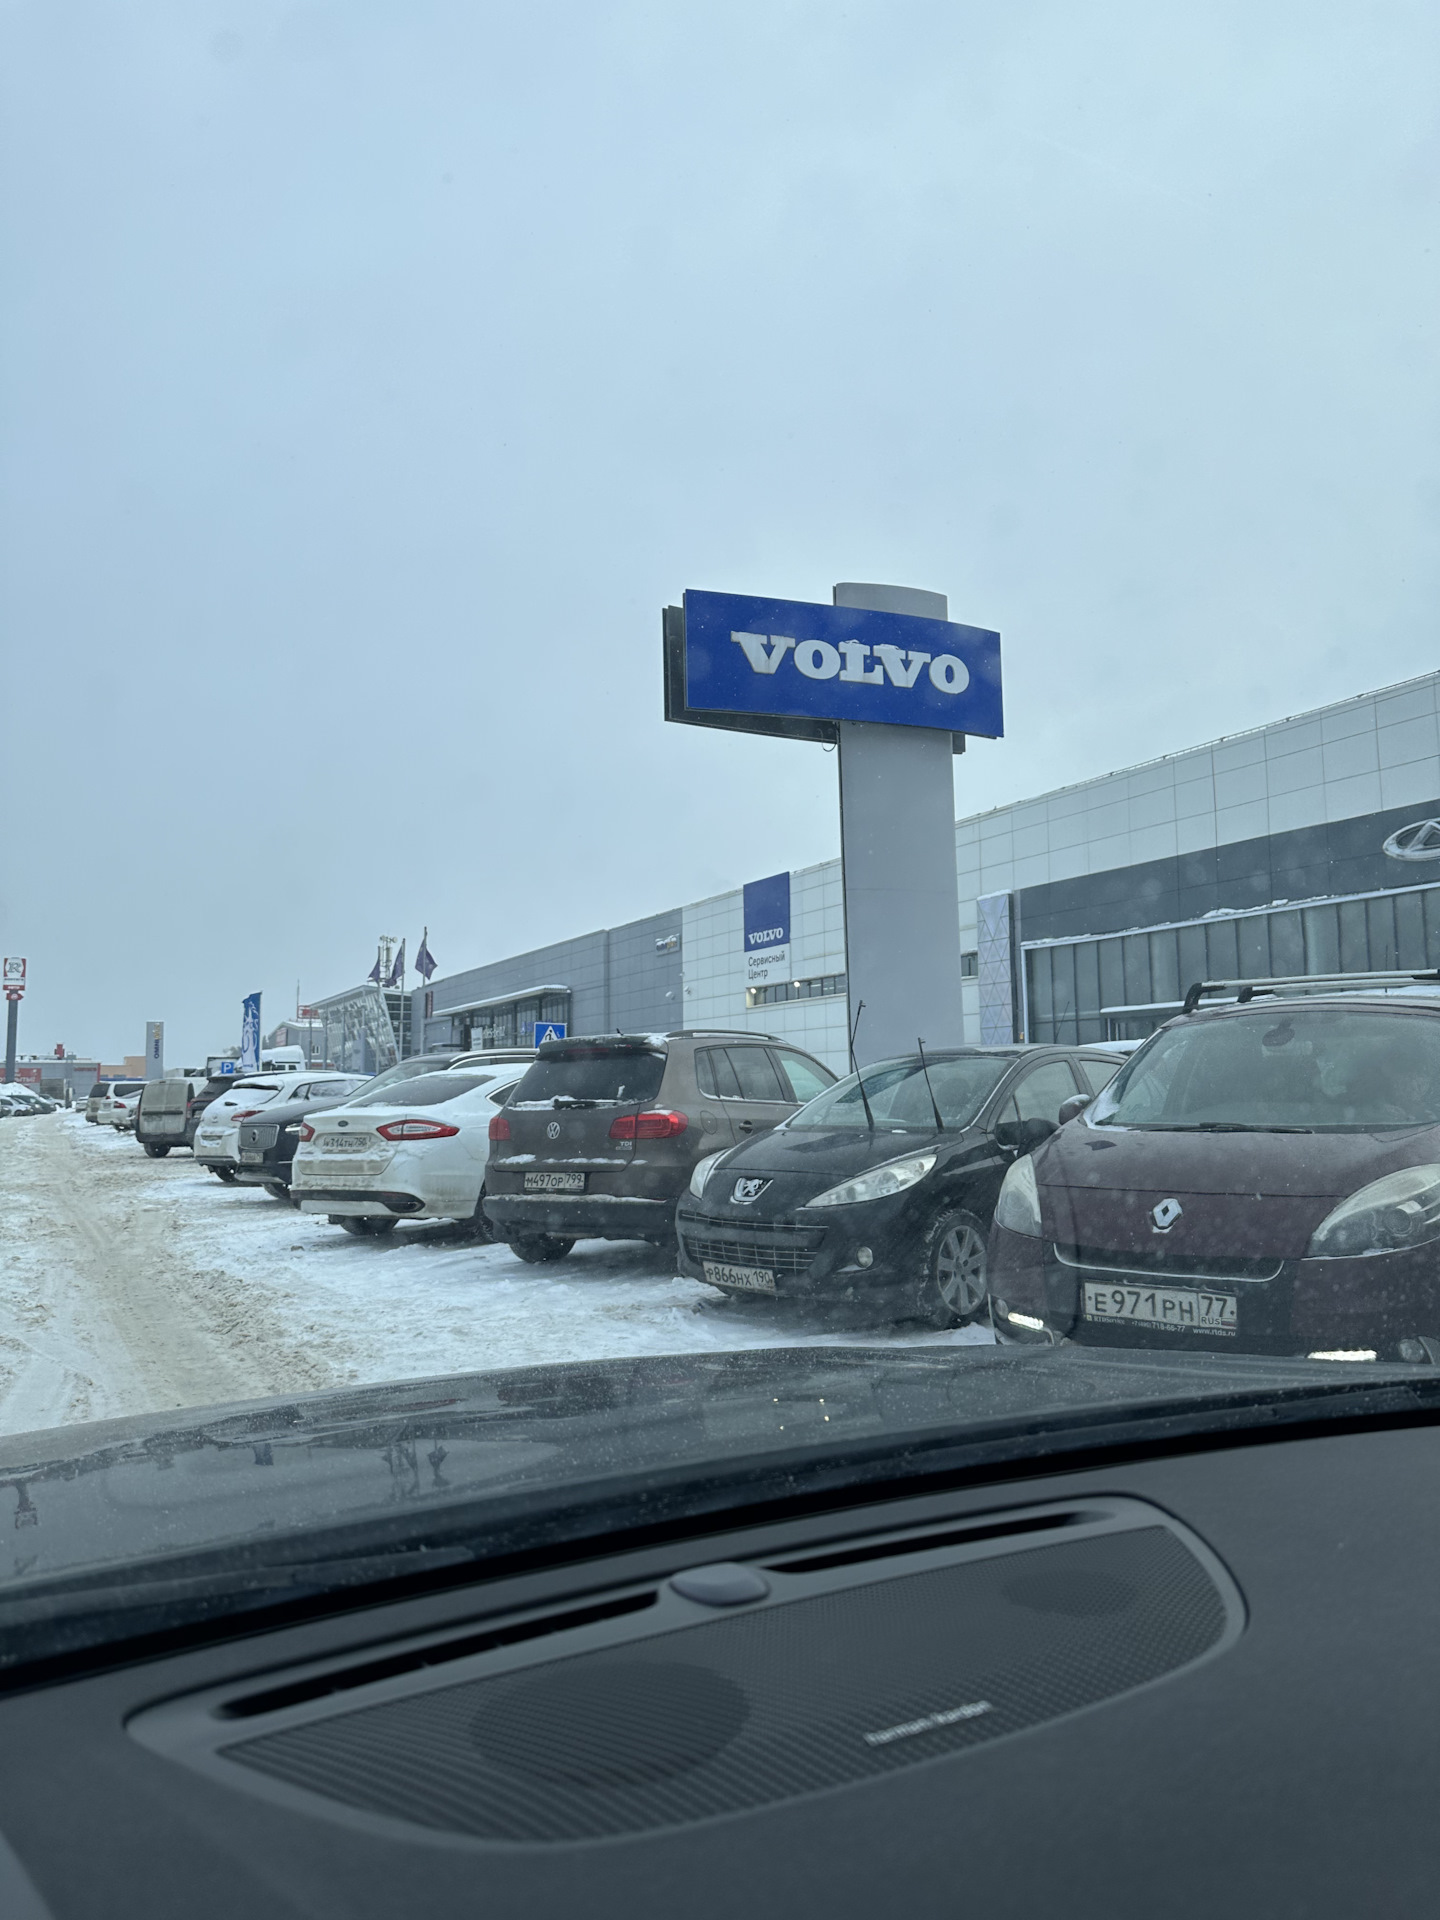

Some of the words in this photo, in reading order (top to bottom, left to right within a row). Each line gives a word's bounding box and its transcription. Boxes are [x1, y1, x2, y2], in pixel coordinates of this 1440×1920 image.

[730, 631, 970, 694] VOLVO
[748, 927, 784, 945] VOLVO
[748, 951, 786, 968] Сервисный
[748, 968, 769, 980] Центр
[565, 1173, 581, 1184] 799
[1201, 1295, 1228, 1318] 77
[1201, 1316, 1221, 1326] RUS
